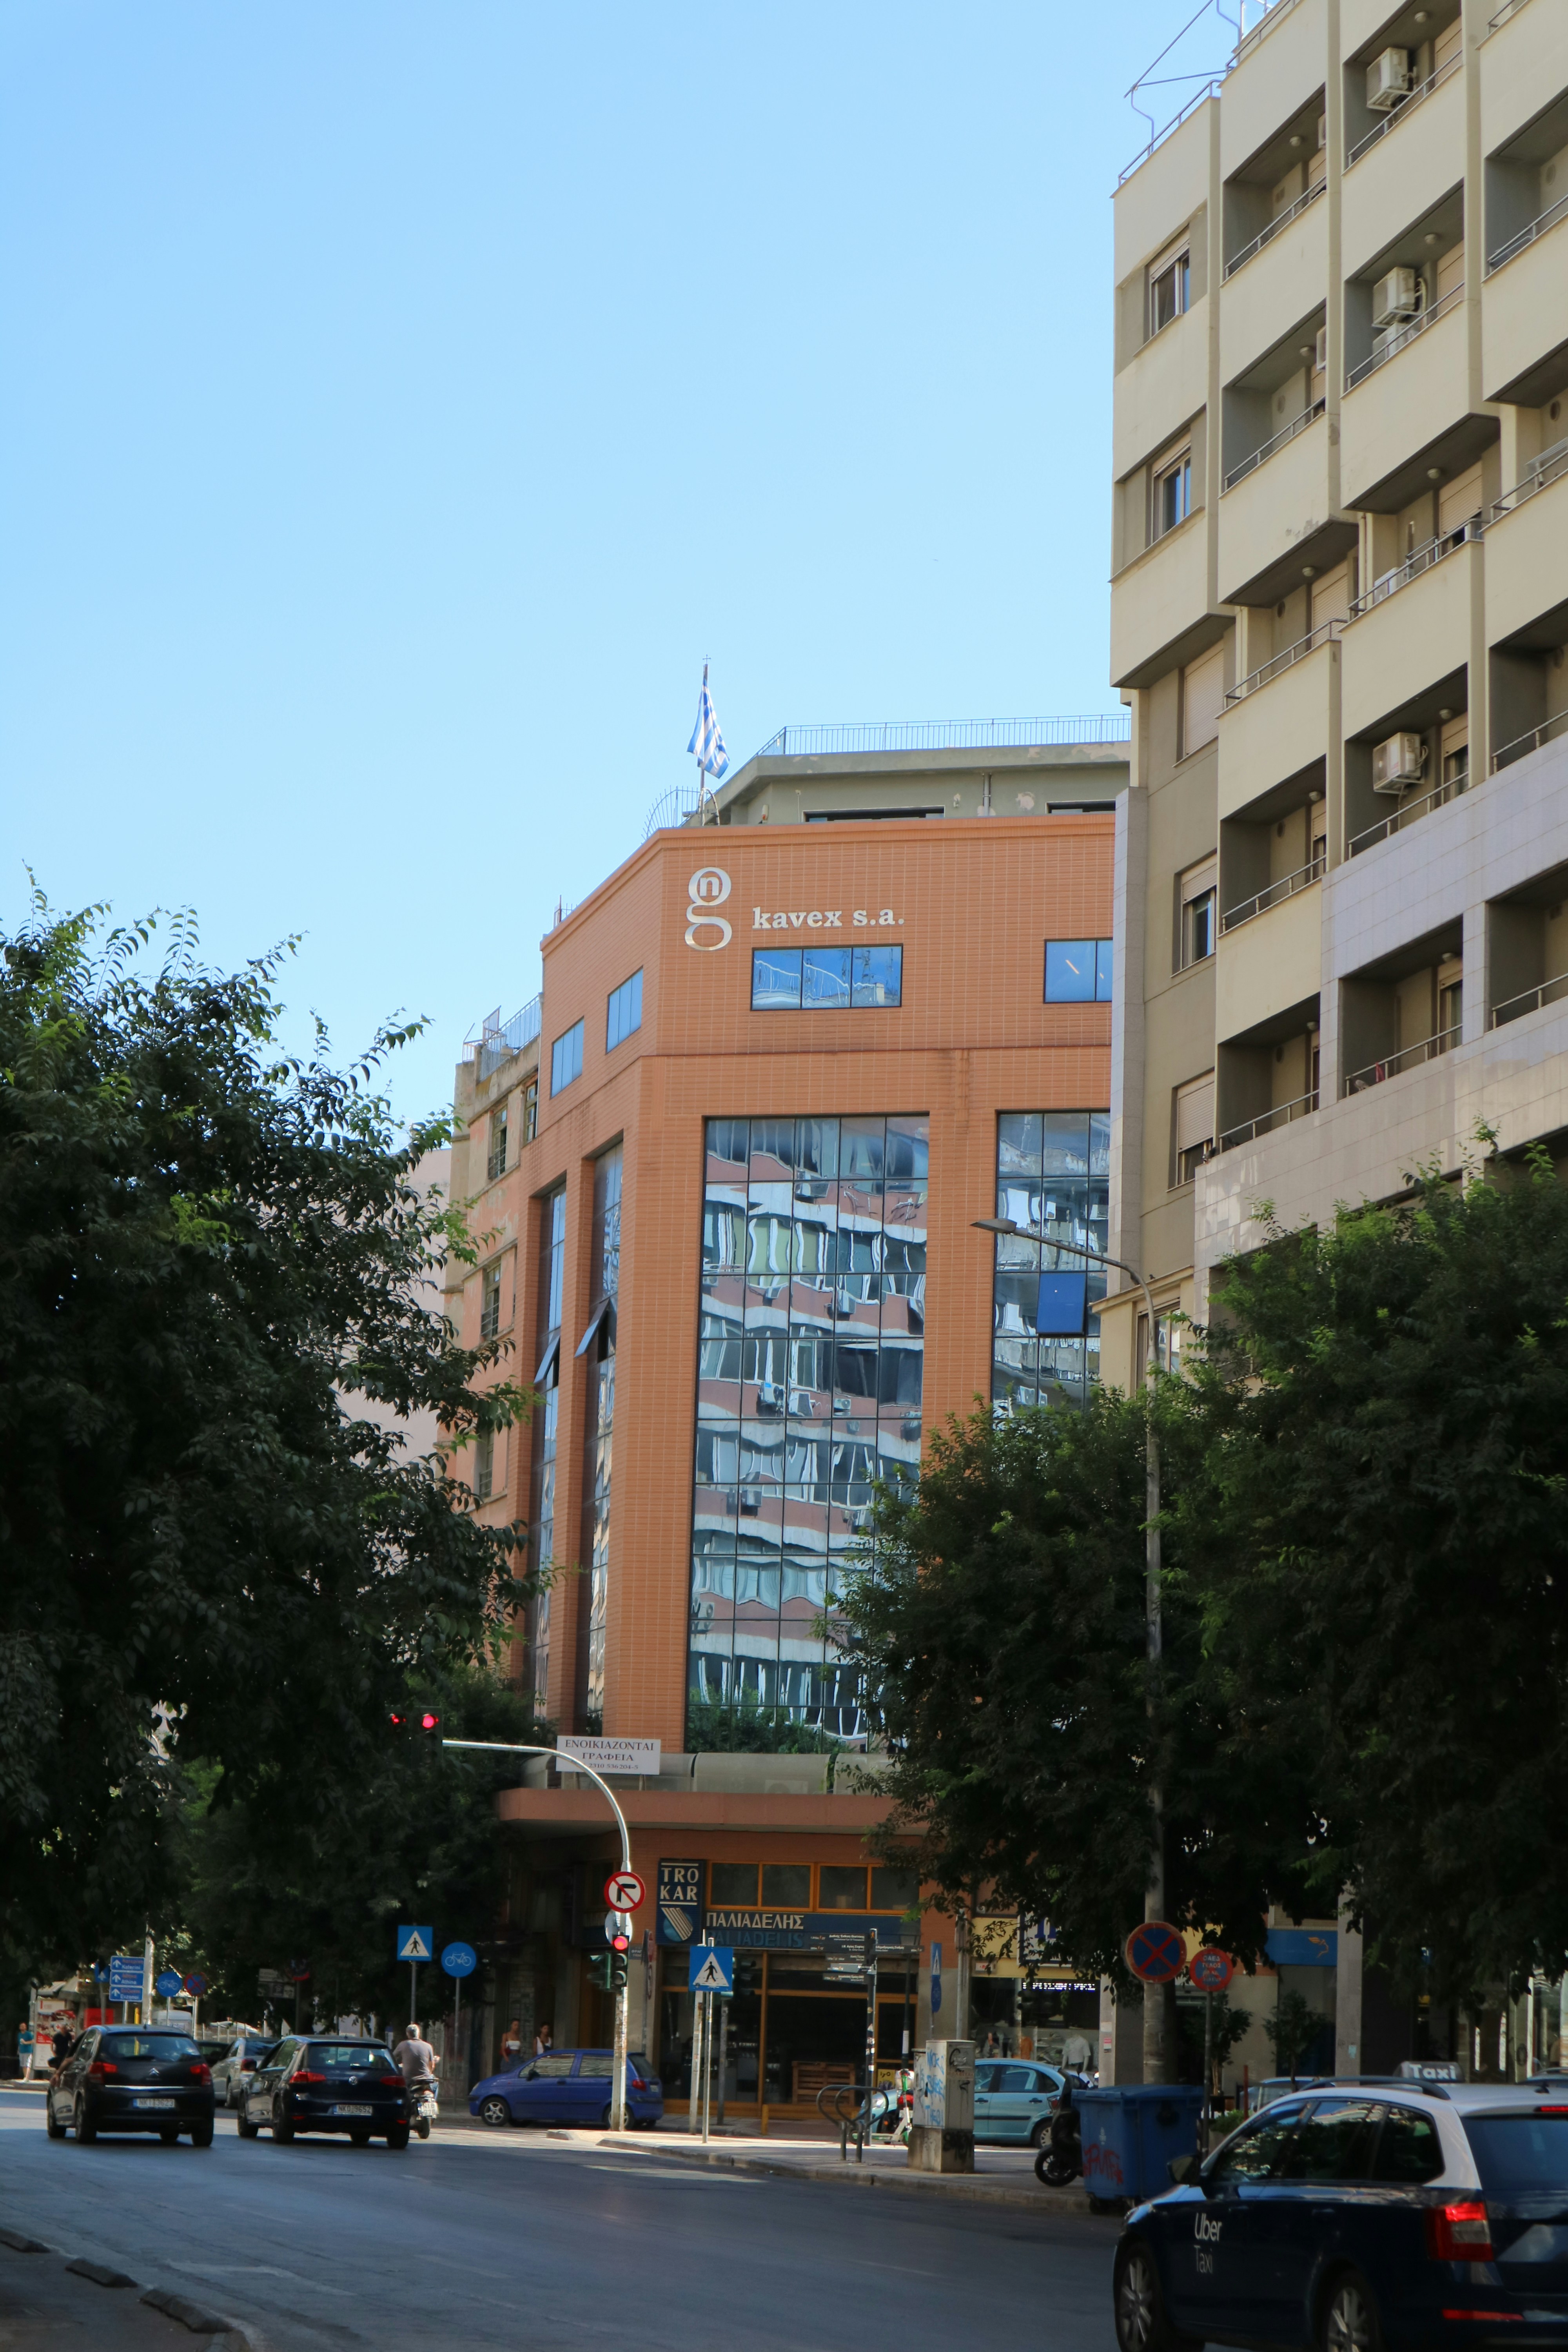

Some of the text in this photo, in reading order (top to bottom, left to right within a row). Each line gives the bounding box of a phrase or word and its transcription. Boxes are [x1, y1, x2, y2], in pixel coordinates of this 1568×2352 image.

[752, 906, 904, 929] kavex s.a.
[565, 1739, 654, 1751] ΕΝΟΙΚΙΑΖΟΝΤΑΙ
[582, 1752, 634, 1761] ΓΡΑΦΕΙΑ
[661, 1868, 699, 1883] TRO
[660, 1885, 697, 1900] KAR
[706, 1912, 804, 1929] ΠΑΛΙΑΔΕΛΗΣ
[1409, 2063, 1457, 2080] Taxi
[1195, 2212, 1222, 2241] Uber
[1194, 2245, 1212, 2274] Taxi
